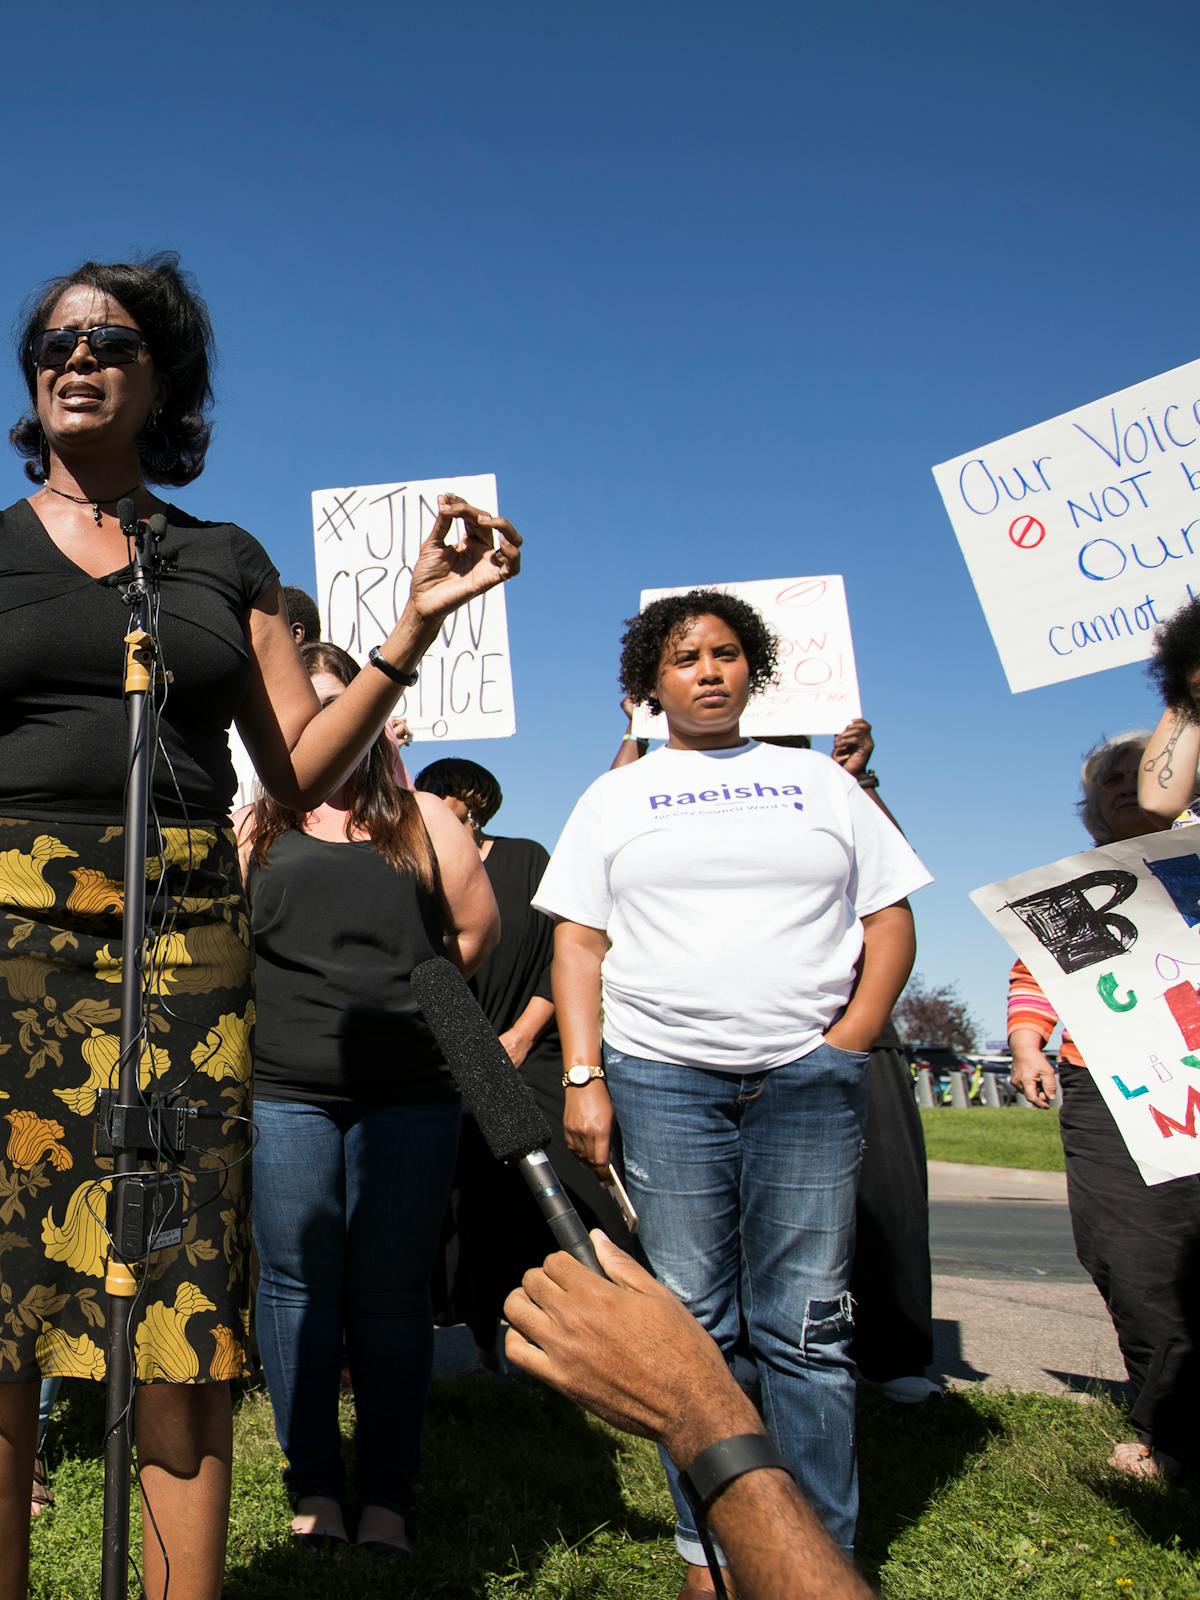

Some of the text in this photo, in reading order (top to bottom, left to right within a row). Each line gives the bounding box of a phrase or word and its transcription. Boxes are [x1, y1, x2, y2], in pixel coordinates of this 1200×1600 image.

[959, 456, 1052, 515] Our
[1066, 471, 1152, 529] NOT
[649, 782, 803, 810] Raeisha
